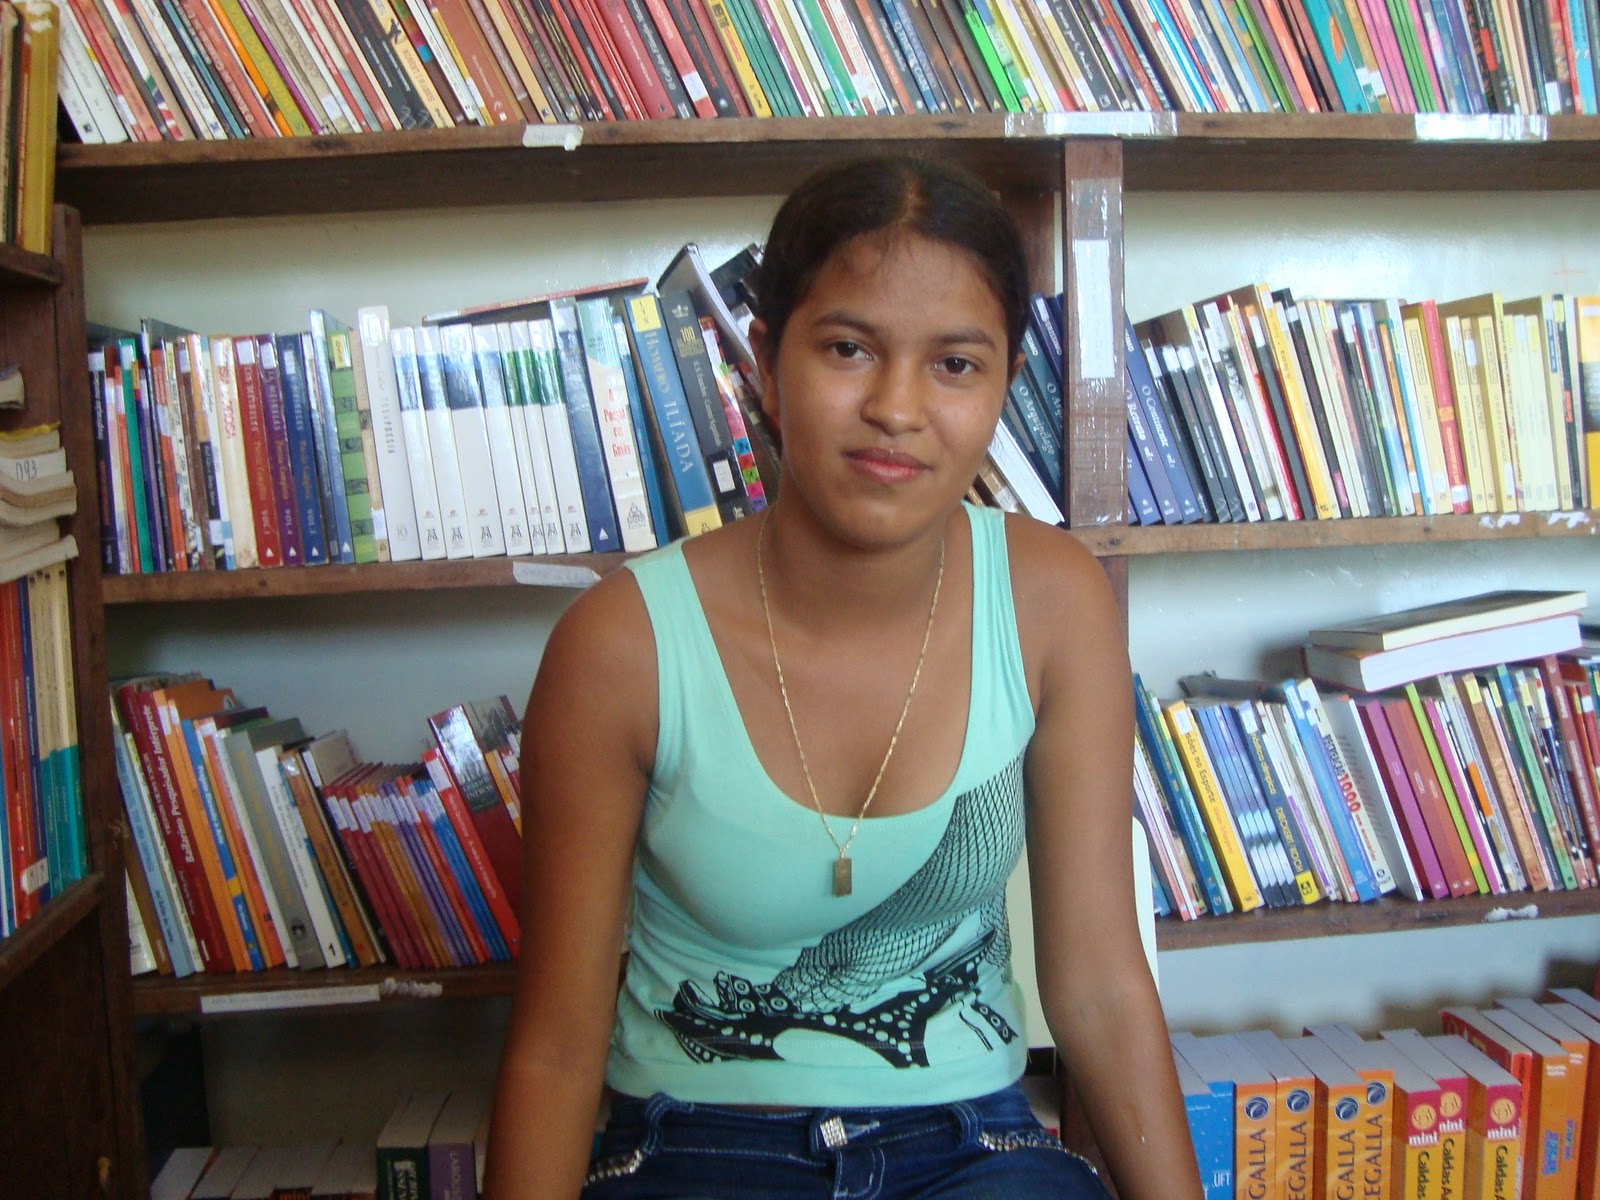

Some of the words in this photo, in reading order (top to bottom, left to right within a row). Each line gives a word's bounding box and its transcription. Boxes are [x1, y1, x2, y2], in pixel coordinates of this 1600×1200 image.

[680, 326, 696, 341] 100
[1017, 384, 1029, 397] O
[1045, 381, 1056, 394] O
[1140, 383, 1152, 396] O
[662, 399, 697, 472] ILÍADA
[1021, 398, 1056, 457] Arquipélago
[1124, 401, 1150, 441] Retrato
[1141, 396, 1173, 448] Continente
[138, 702, 166, 755] Intérprete
[1183, 731, 1200, 755] esões
[1248, 731, 1267, 761] nástica
[1193, 756, 1204, 768] no
[1320, 733, 1348, 777] RECREAÇÃO
[1336, 772, 1362, 813] 1000
[153, 754, 183, 816] Pesquisador
[1197, 769, 1218, 804] Esporte
[172, 816, 196, 864] Bailarino
[1408, 1130, 1438, 1146] mini
[1487, 1125, 1517, 1140] mini
[1211, 1171, 1231, 1188] UFT
[1417, 1151, 1430, 1198] Caldas
[1441, 1137, 1455, 1185] Caldas
[1495, 1145, 1508, 1194] Caldas
